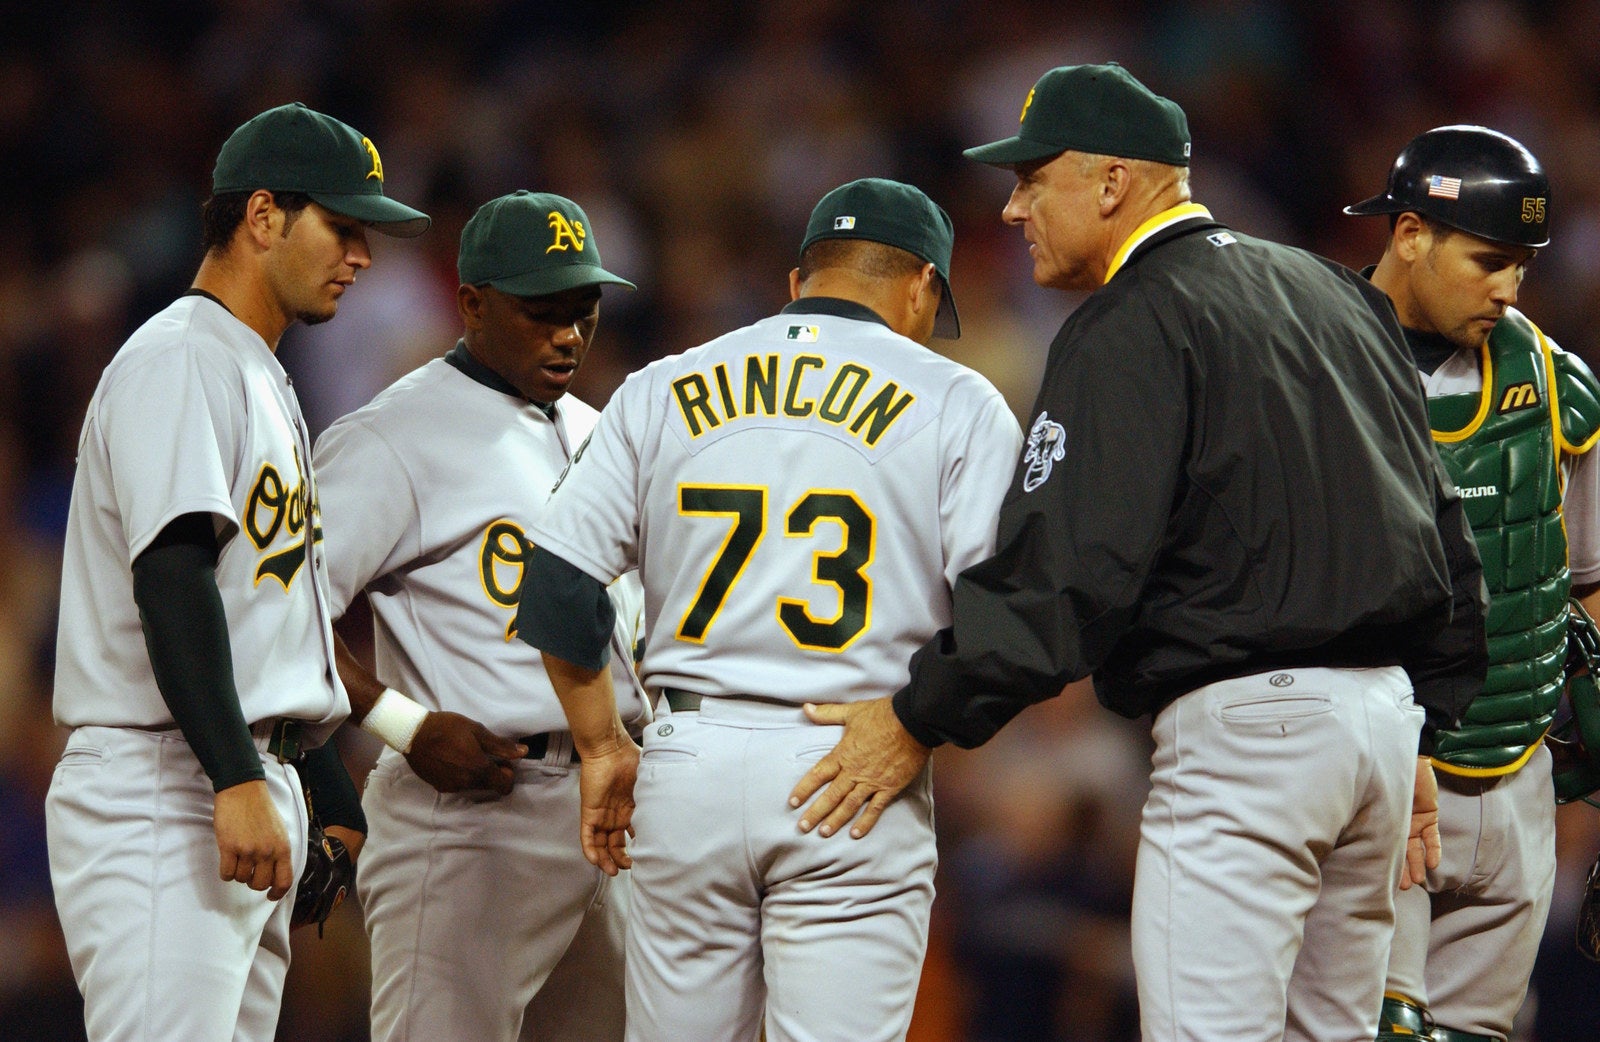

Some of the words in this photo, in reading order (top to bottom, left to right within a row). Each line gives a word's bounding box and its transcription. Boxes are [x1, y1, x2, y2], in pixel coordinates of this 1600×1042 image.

[1521, 197, 1547, 224] 55
[671, 354, 915, 449] RINCON
[675, 483, 878, 654] 73
